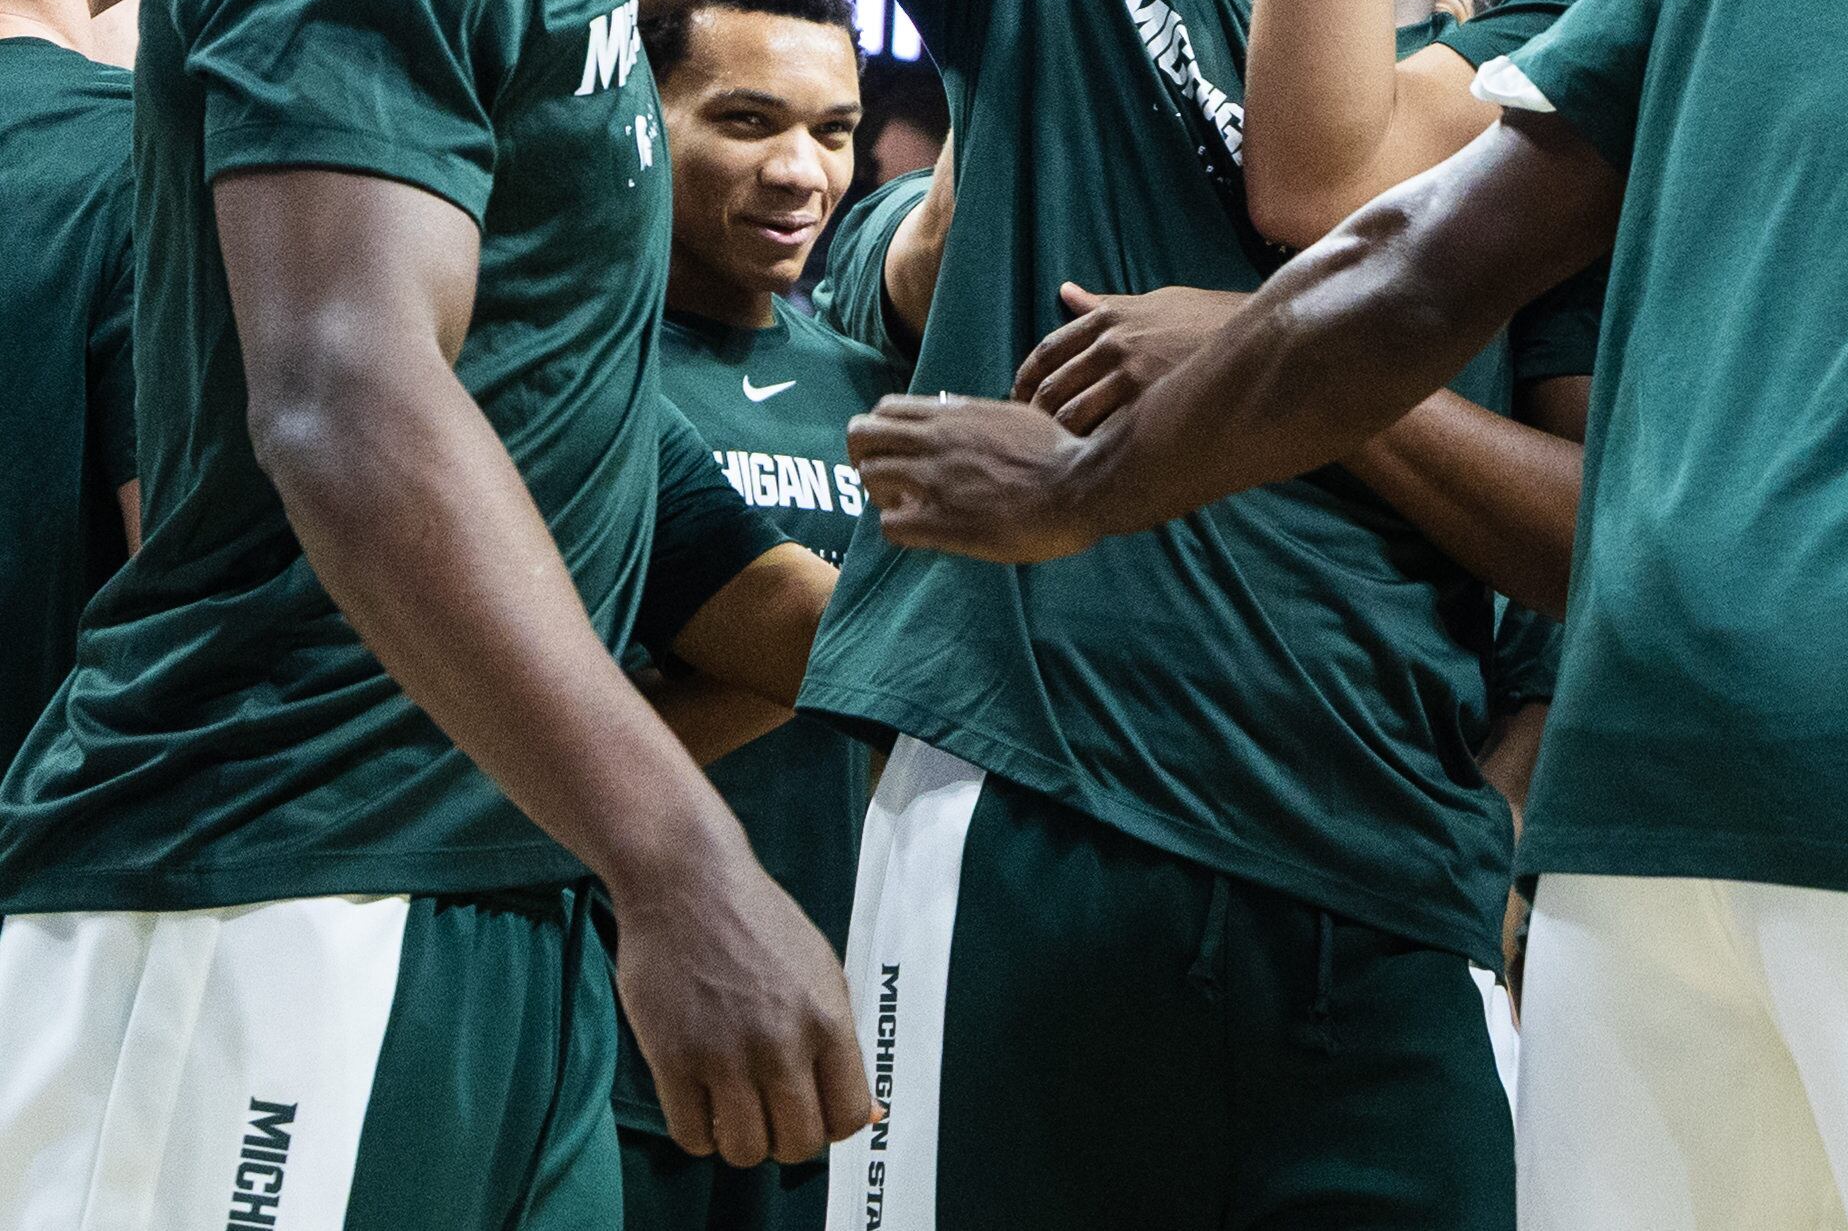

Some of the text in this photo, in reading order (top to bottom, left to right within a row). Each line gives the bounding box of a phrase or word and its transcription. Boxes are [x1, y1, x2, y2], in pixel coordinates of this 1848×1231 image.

[225, 1096, 298, 1231] MICHI
[866, 963, 900, 1231] MICHIGAN STA
